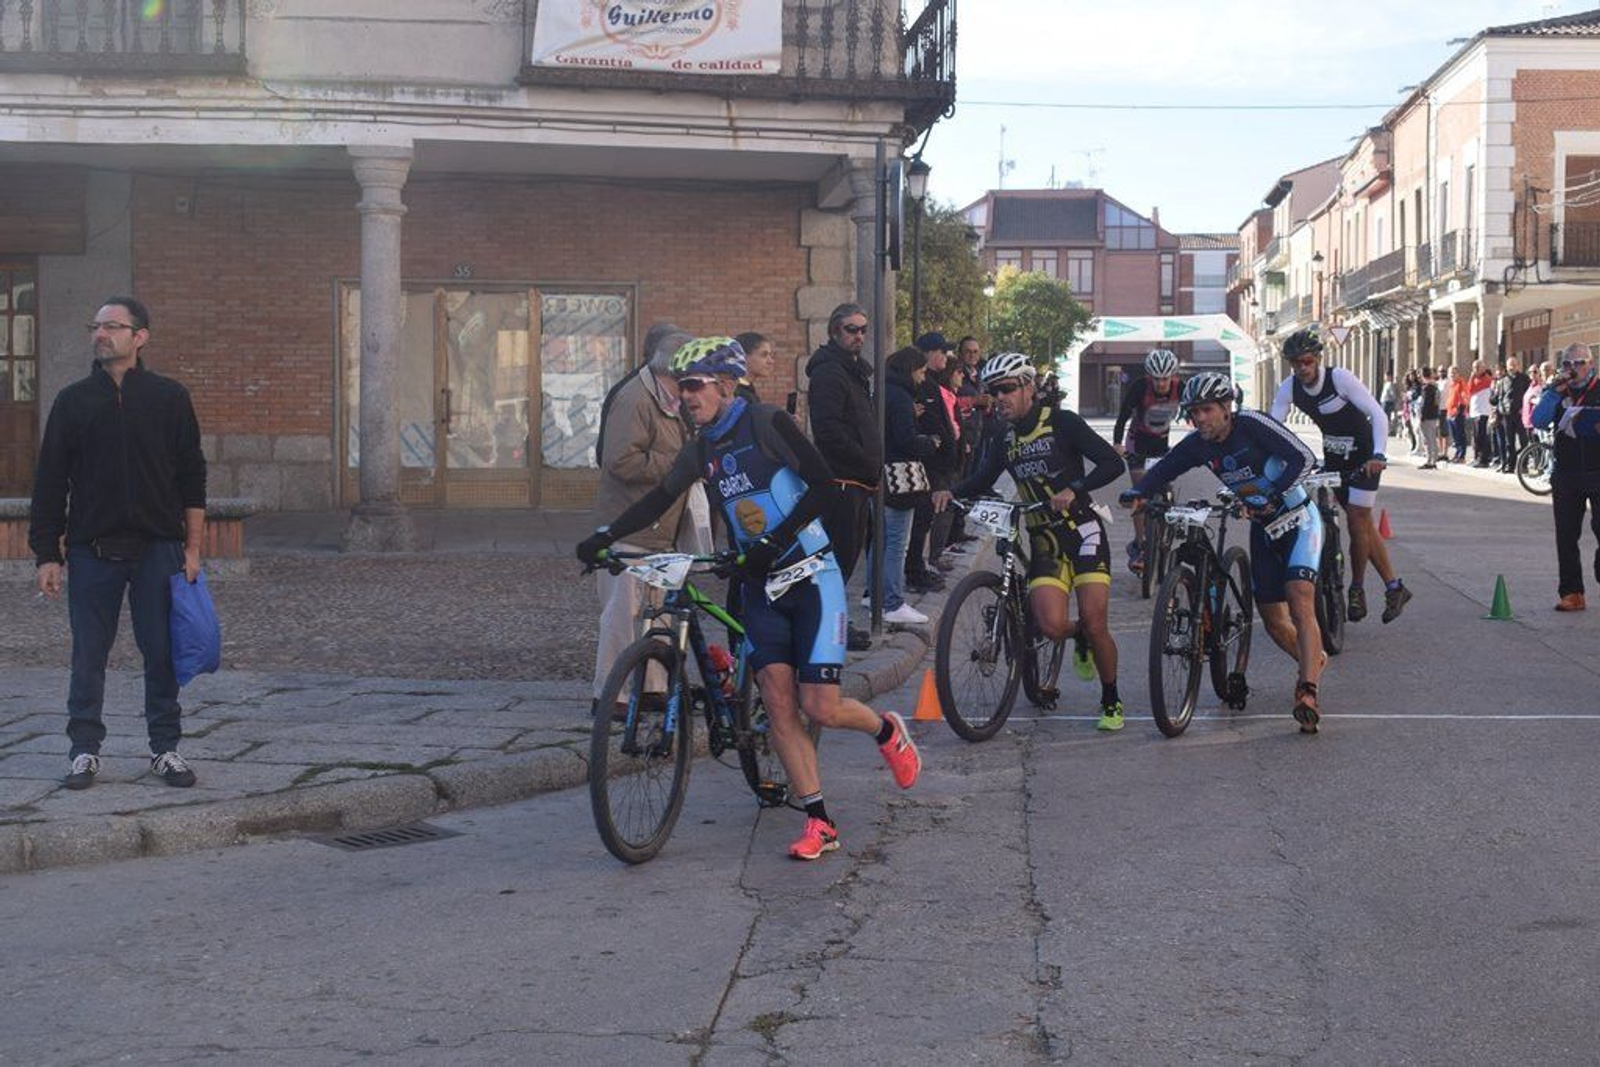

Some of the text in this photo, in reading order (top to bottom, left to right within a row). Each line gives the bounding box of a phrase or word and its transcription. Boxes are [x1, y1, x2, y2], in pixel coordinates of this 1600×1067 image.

[608, 5, 713, 26] Guillermo
[671, 59, 692, 70] de
[698, 60, 763, 71] calidad
[980, 510, 999, 524] 92
